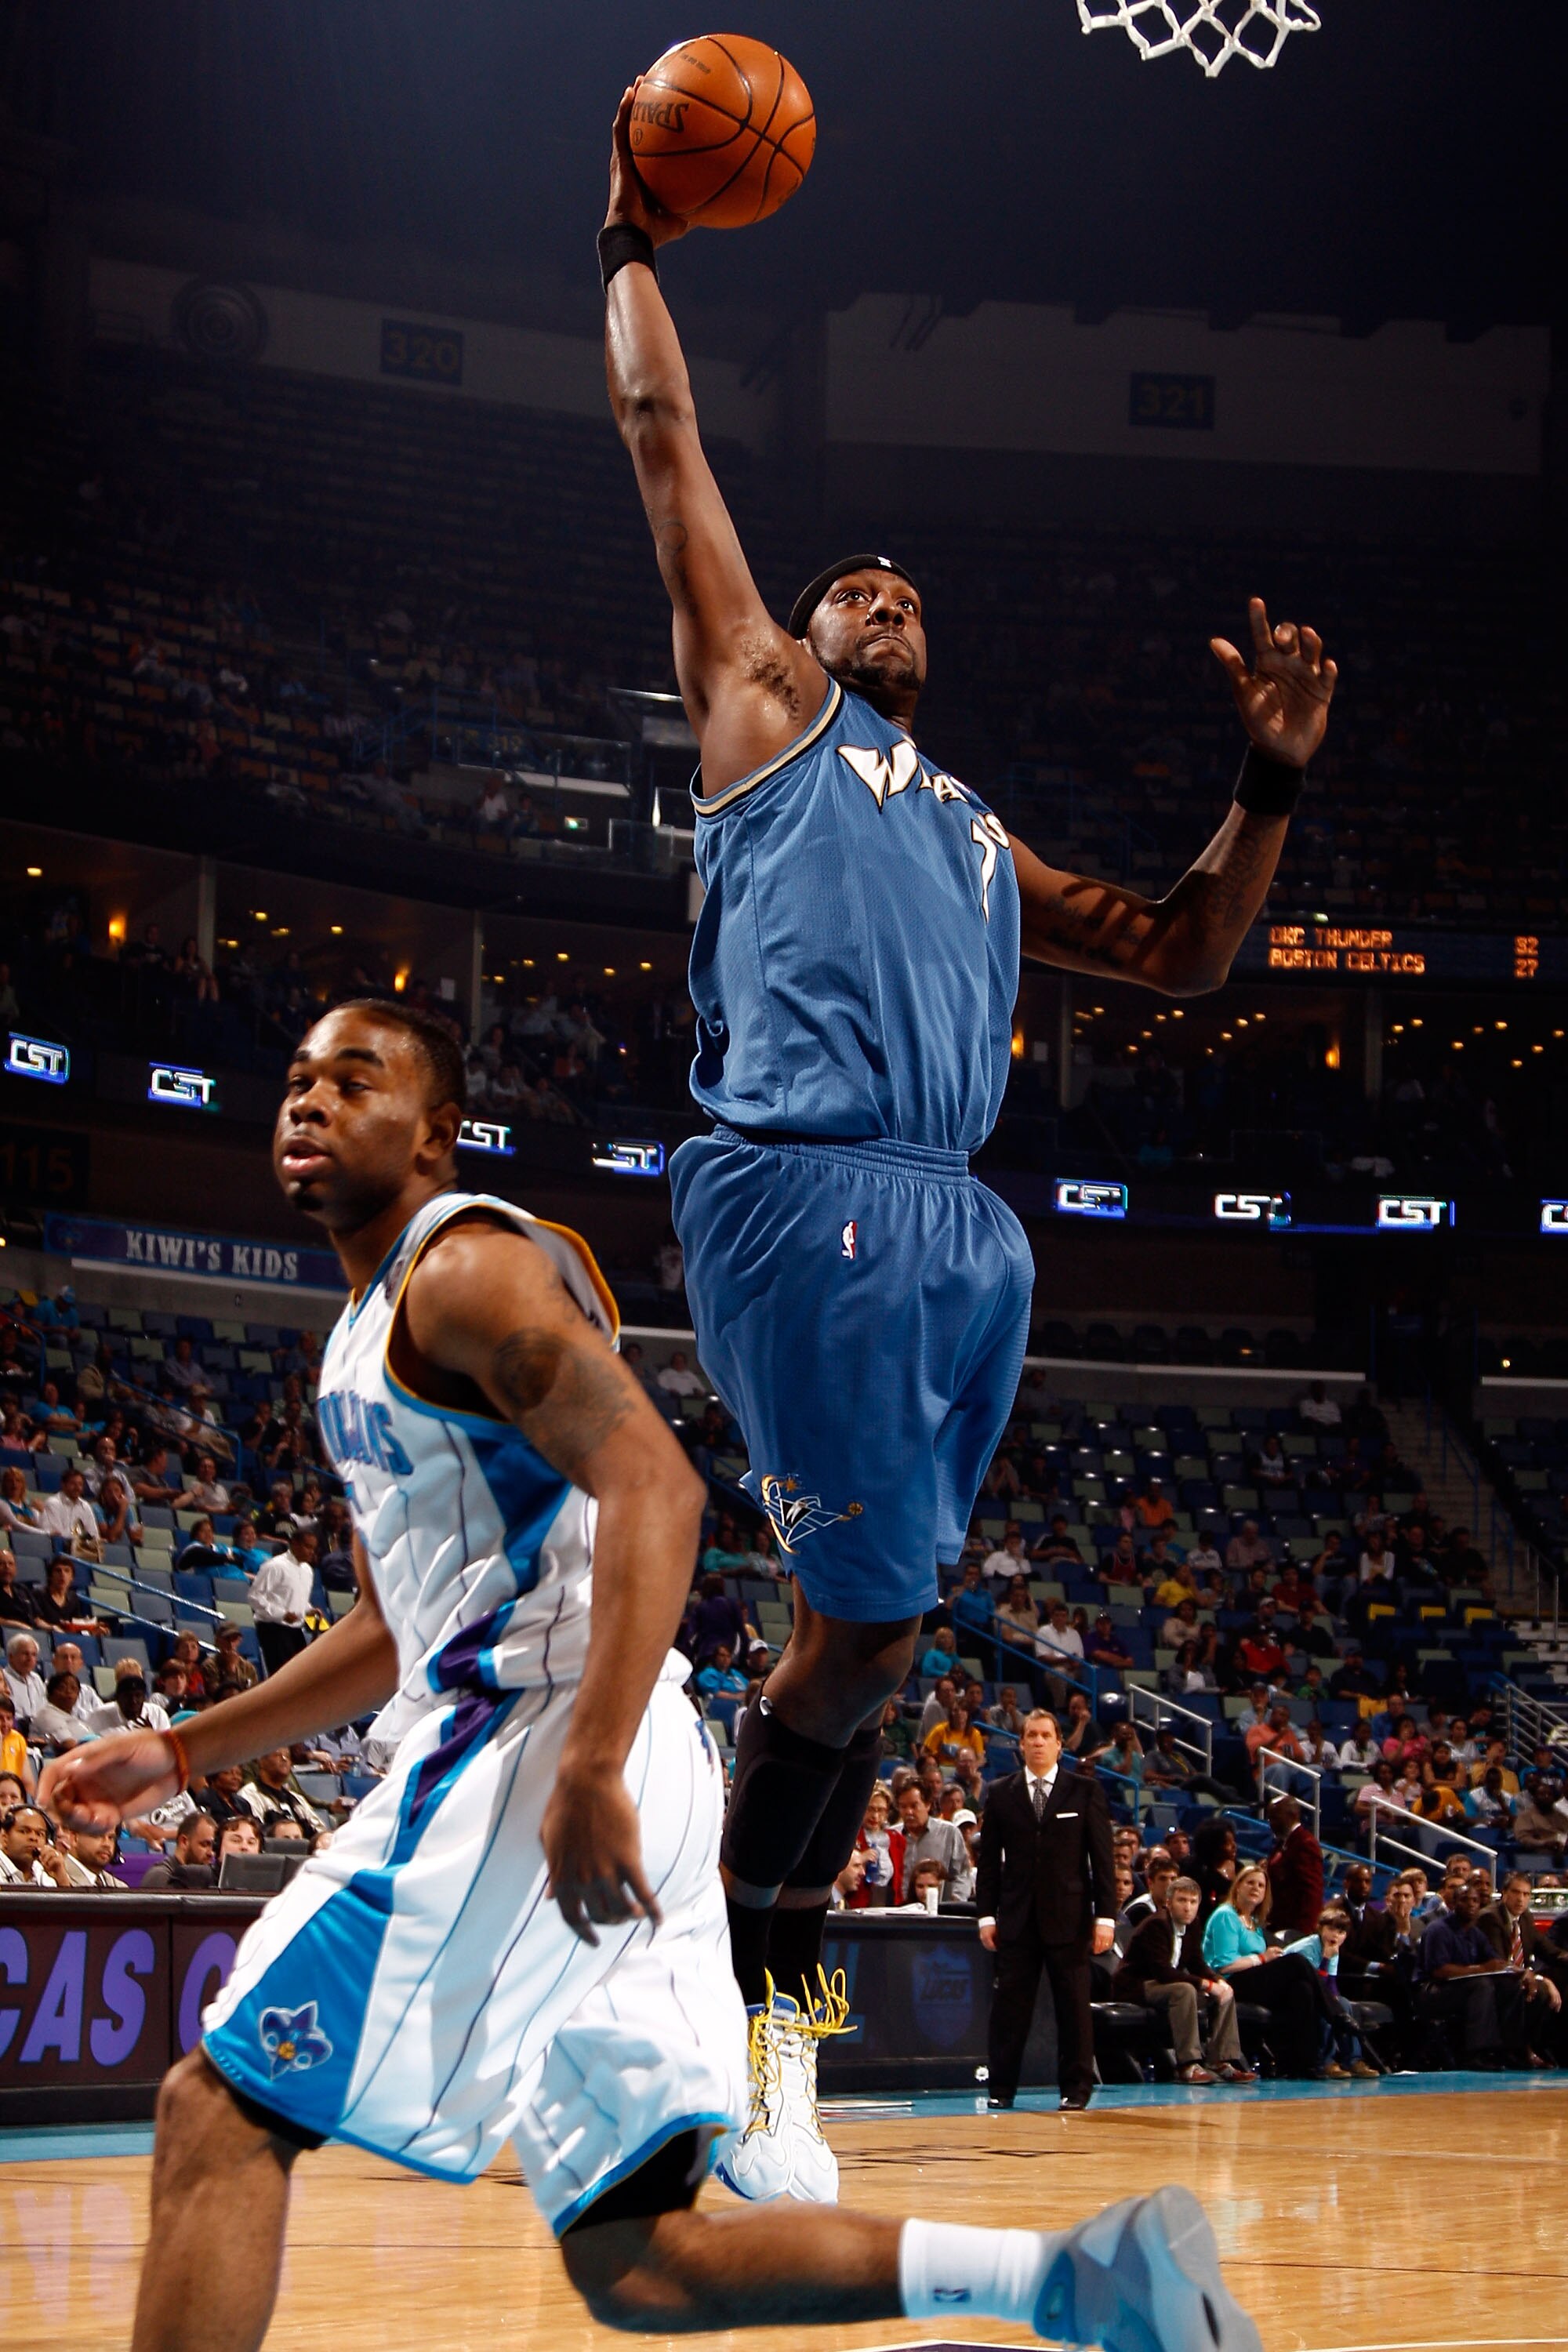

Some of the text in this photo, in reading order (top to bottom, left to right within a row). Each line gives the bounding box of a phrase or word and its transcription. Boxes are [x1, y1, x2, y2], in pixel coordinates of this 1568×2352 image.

[387, 330, 459, 373] 320
[1315, 927, 1393, 949] THUNDER
[1269, 947, 1338, 970] BOSTON
[1345, 952, 1426, 976] CELTICS
[9, 1038, 64, 1076] CST
[1378, 1199, 1447, 1225] CST
[125, 1229, 299, 1281] KIWI'S KIDS
